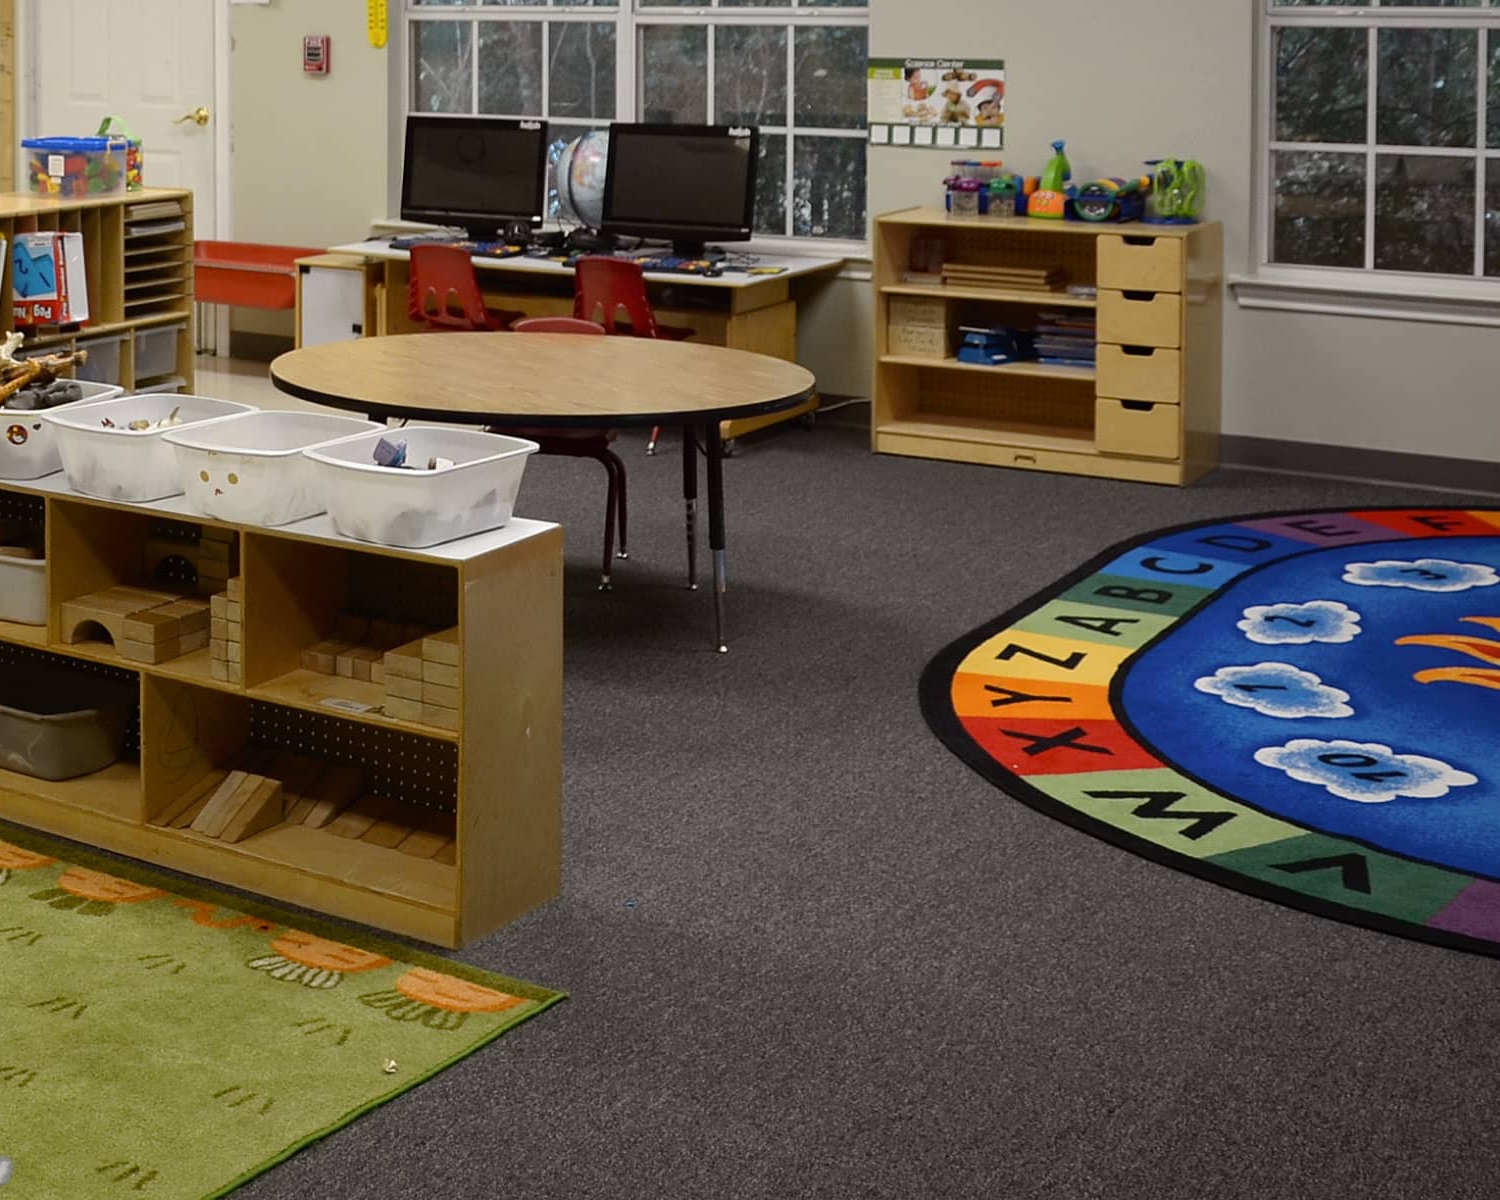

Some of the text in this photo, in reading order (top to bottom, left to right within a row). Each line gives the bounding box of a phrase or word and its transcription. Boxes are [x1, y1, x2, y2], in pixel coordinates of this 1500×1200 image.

[34, 304, 52, 319] Peg
[1283, 520, 1360, 537] E
[1408, 515, 1464, 531] F
[1197, 536, 1272, 553] D
[1140, 556, 1214, 575] C
[1399, 568, 1448, 581] 3
[1092, 585, 1173, 604] B
[1054, 615, 1141, 636] A
[1263, 614, 1317, 627] 2
[994, 643, 1088, 670] Z
[984, 684, 1073, 707] Y
[1233, 683, 1288, 693] 1
[1000, 726, 1115, 757] X
[1317, 753, 1408, 782] 10
[1267, 852, 1373, 895] V
